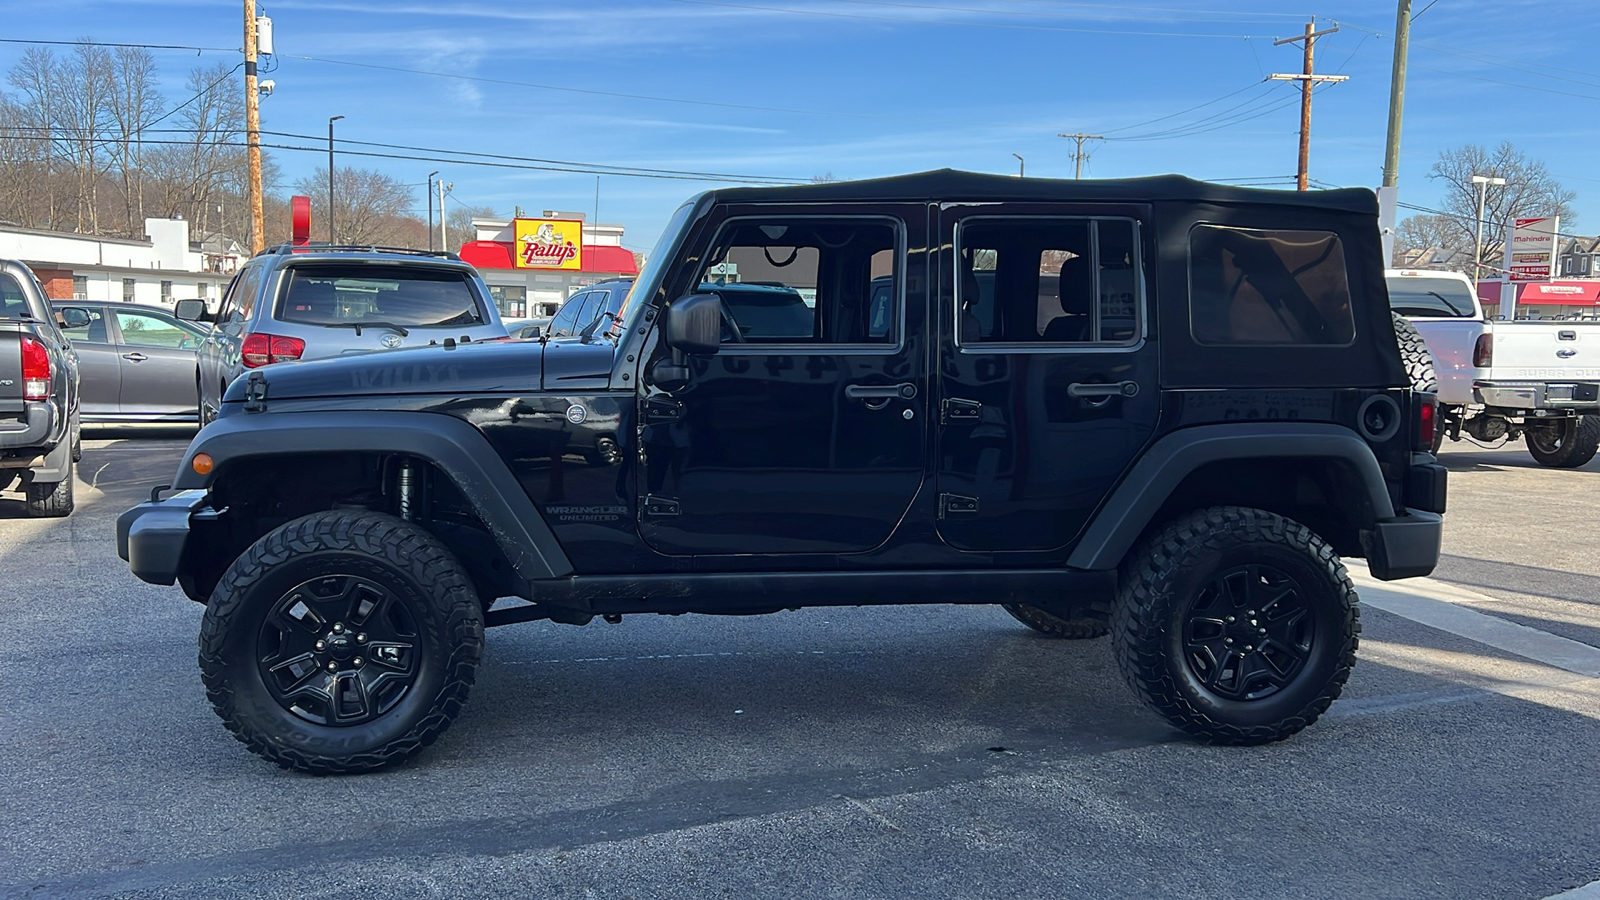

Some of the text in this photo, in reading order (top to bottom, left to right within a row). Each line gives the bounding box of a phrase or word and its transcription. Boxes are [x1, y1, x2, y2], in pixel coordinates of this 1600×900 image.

[521, 241, 577, 265] Rally's
[1518, 369, 1566, 377] SUPER
[546, 506, 628, 514] WRANGLER
